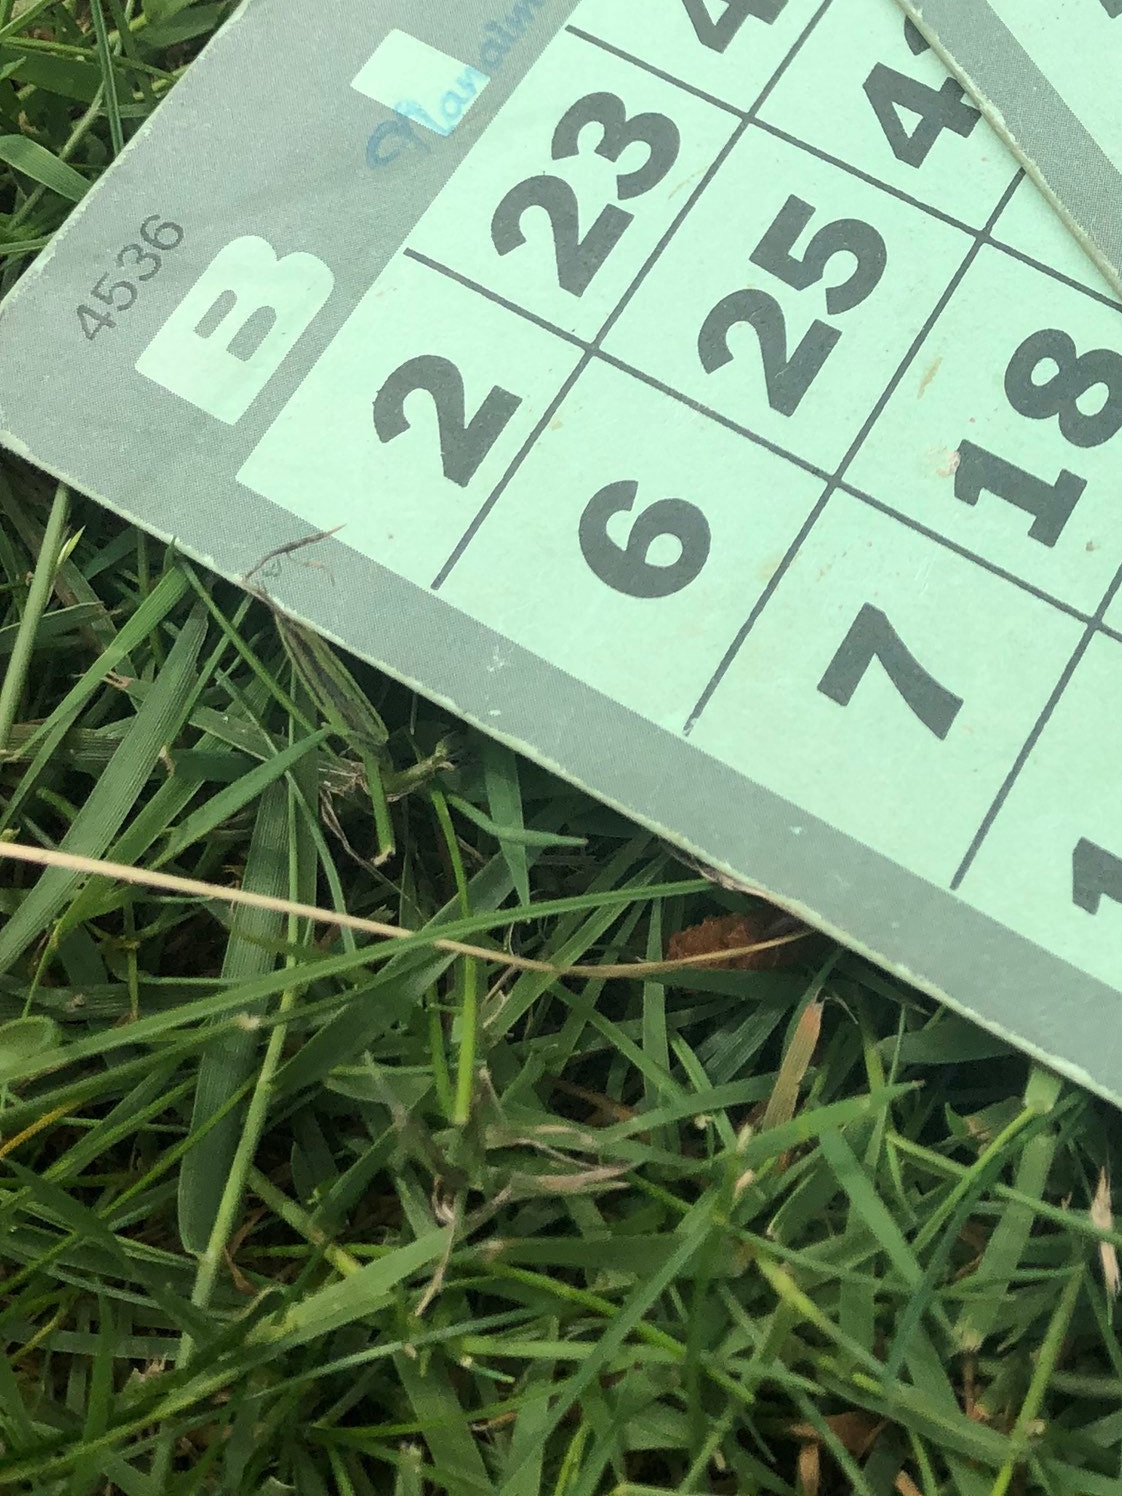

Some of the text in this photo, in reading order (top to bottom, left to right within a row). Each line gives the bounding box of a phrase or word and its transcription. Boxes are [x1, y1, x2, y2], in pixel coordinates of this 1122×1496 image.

[77, 214, 184, 341] 4536
[372, 355, 522, 488] 2
[491, 92, 680, 297] 23
[578, 15, 982, 598] 6 25 4
[817, 603, 963, 740] 7
